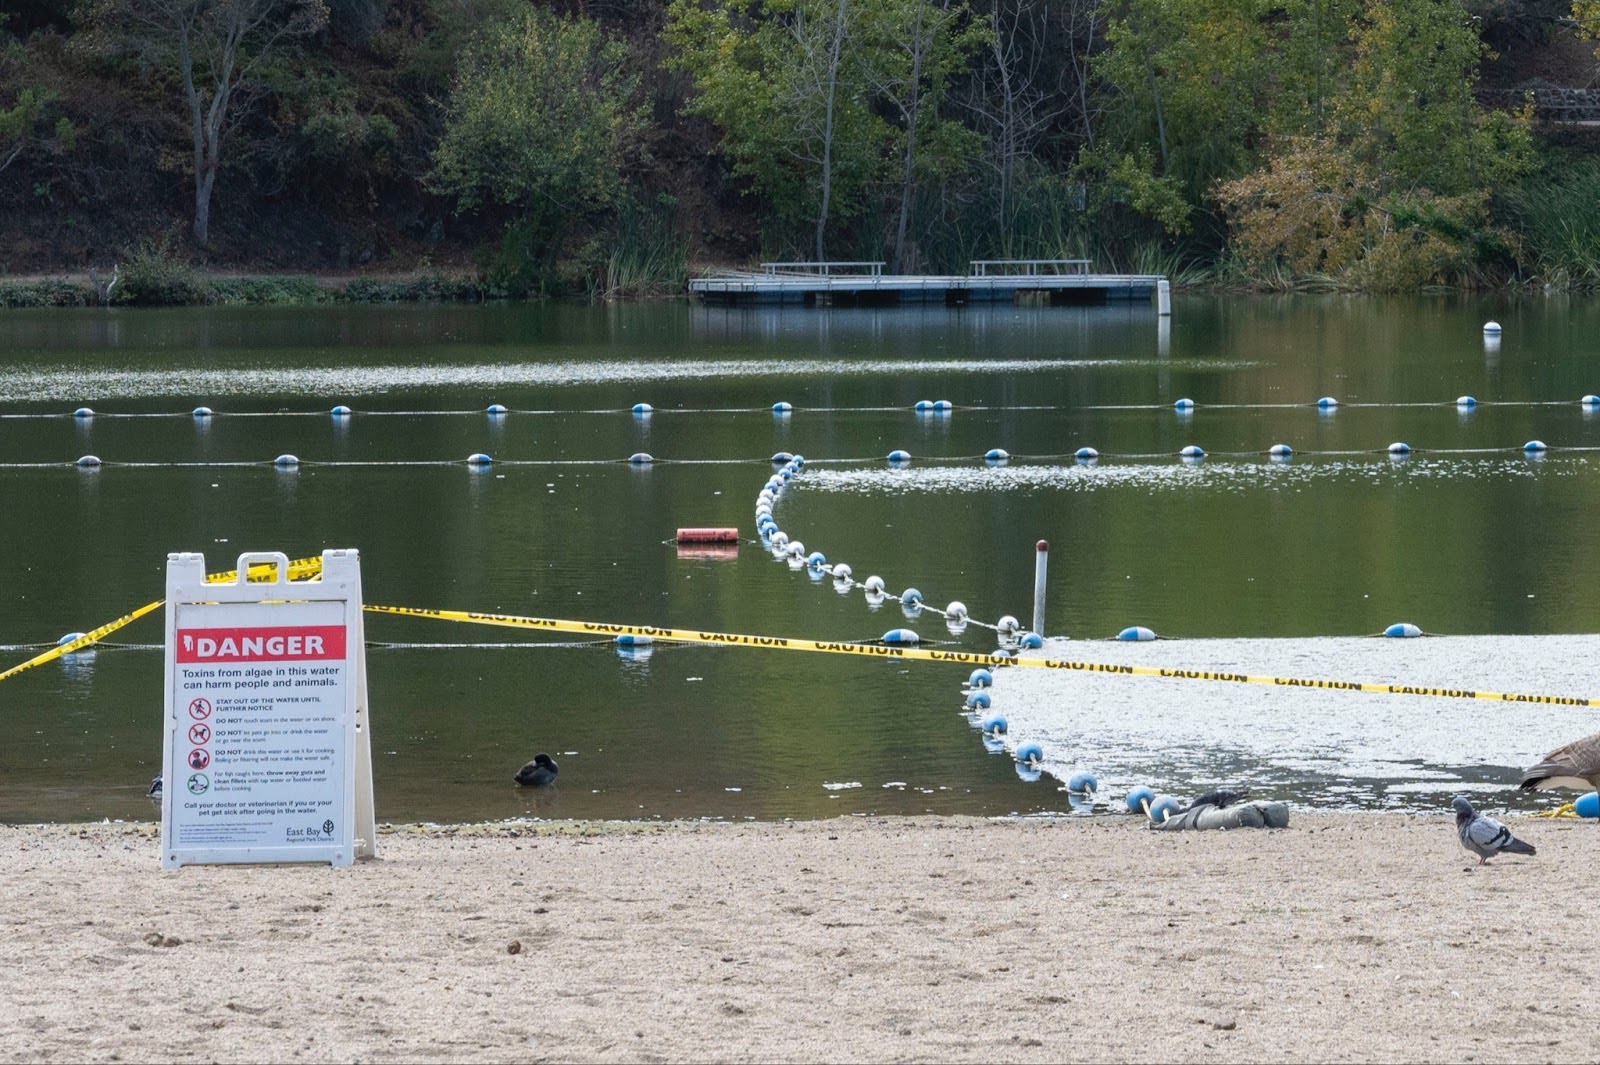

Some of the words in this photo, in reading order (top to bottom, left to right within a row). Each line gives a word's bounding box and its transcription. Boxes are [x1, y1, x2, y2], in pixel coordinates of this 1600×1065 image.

[197, 636, 325, 657] DANGER
[182, 670, 214, 678] Toxins
[218, 668, 242, 677] from
[245, 668, 272, 678] algae
[276, 667, 285, 676] in
[288, 666, 307, 676] this
[310, 667, 340, 676] water
[205, 680, 232, 688] harm
[234, 680, 269, 690] people
[272, 678, 292, 687] and
[294, 678, 338, 686] animals.
[286, 828, 304, 836] East
[306, 827, 320, 837] Bay
